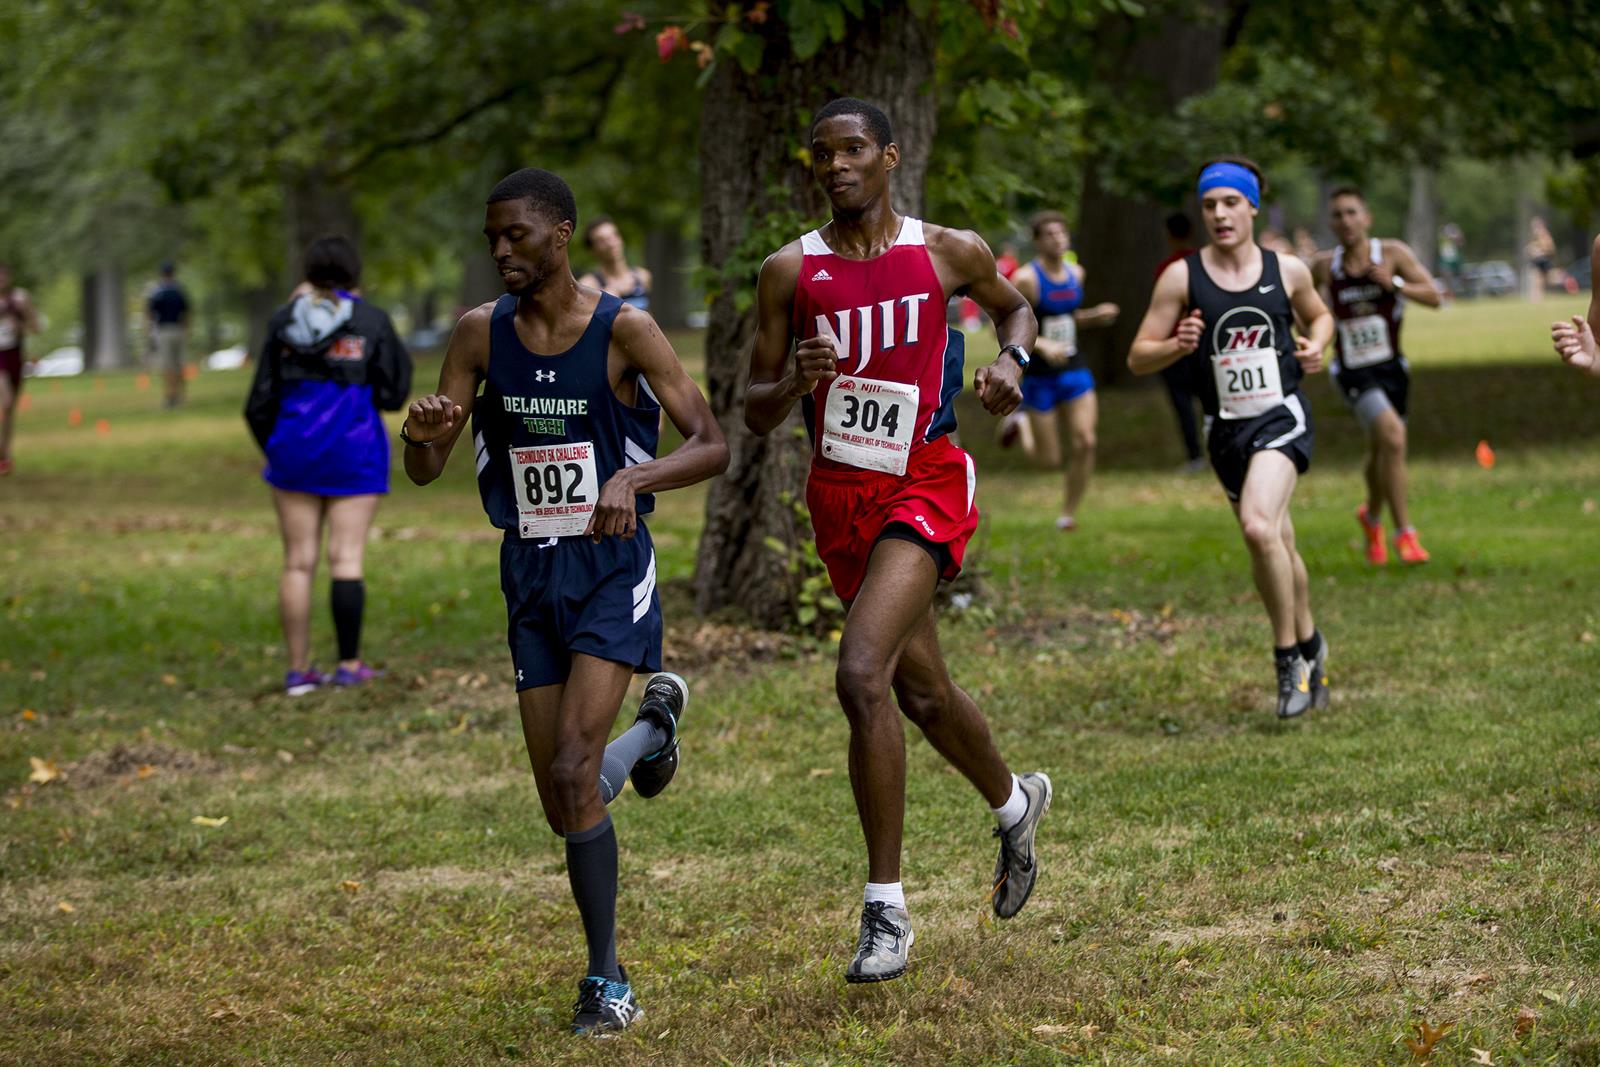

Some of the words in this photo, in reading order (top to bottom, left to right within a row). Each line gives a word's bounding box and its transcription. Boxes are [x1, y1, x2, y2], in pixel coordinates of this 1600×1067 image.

[815, 293, 930, 375] NJIT
[861, 383, 882, 393] NJIT
[1226, 366, 1267, 393] 201
[502, 395, 588, 415] DELAWARE
[523, 417, 566, 436] TECH
[840, 395, 900, 438] 304
[515, 449, 547, 464] TECHNOLOGY
[556, 446, 588, 462] CHALLENGE
[880, 440, 903, 451] TECHNOLOGY
[524, 462, 587, 505] 892
